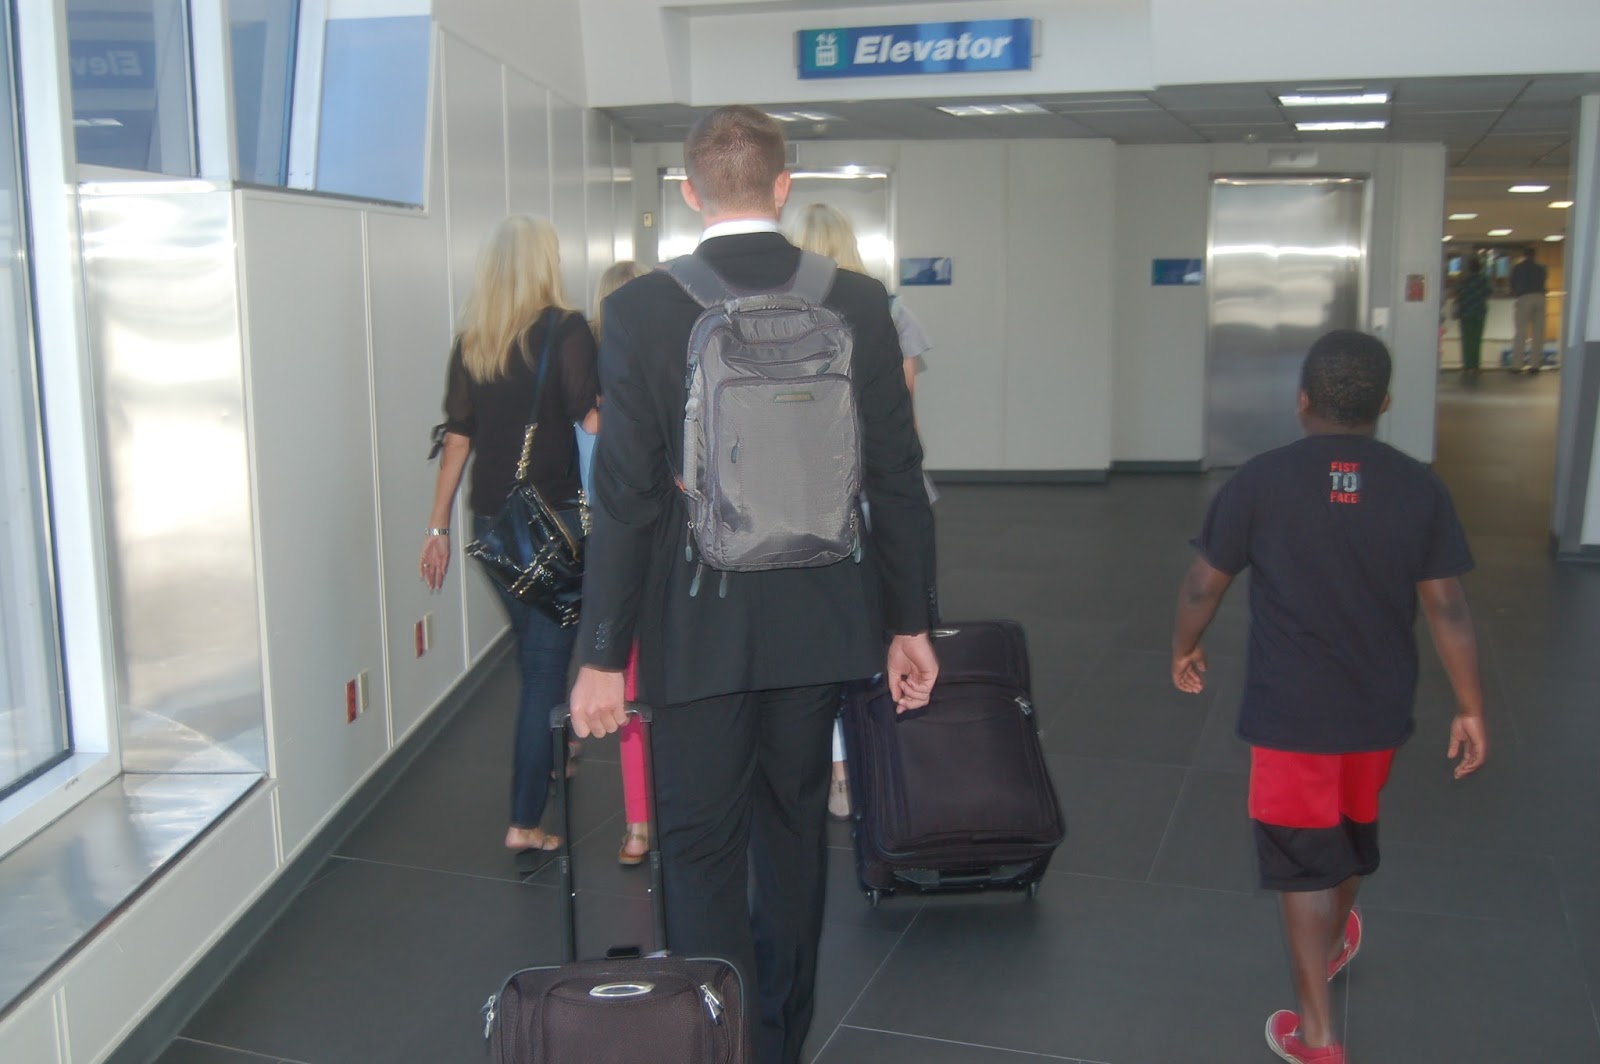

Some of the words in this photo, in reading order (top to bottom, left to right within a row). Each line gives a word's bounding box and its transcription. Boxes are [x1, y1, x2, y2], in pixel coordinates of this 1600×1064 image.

[853, 32, 1012, 65] Elevator
[1330, 461, 1359, 472] FIST
[1329, 471, 1358, 493] TO
[1330, 492, 1359, 504] FACE
